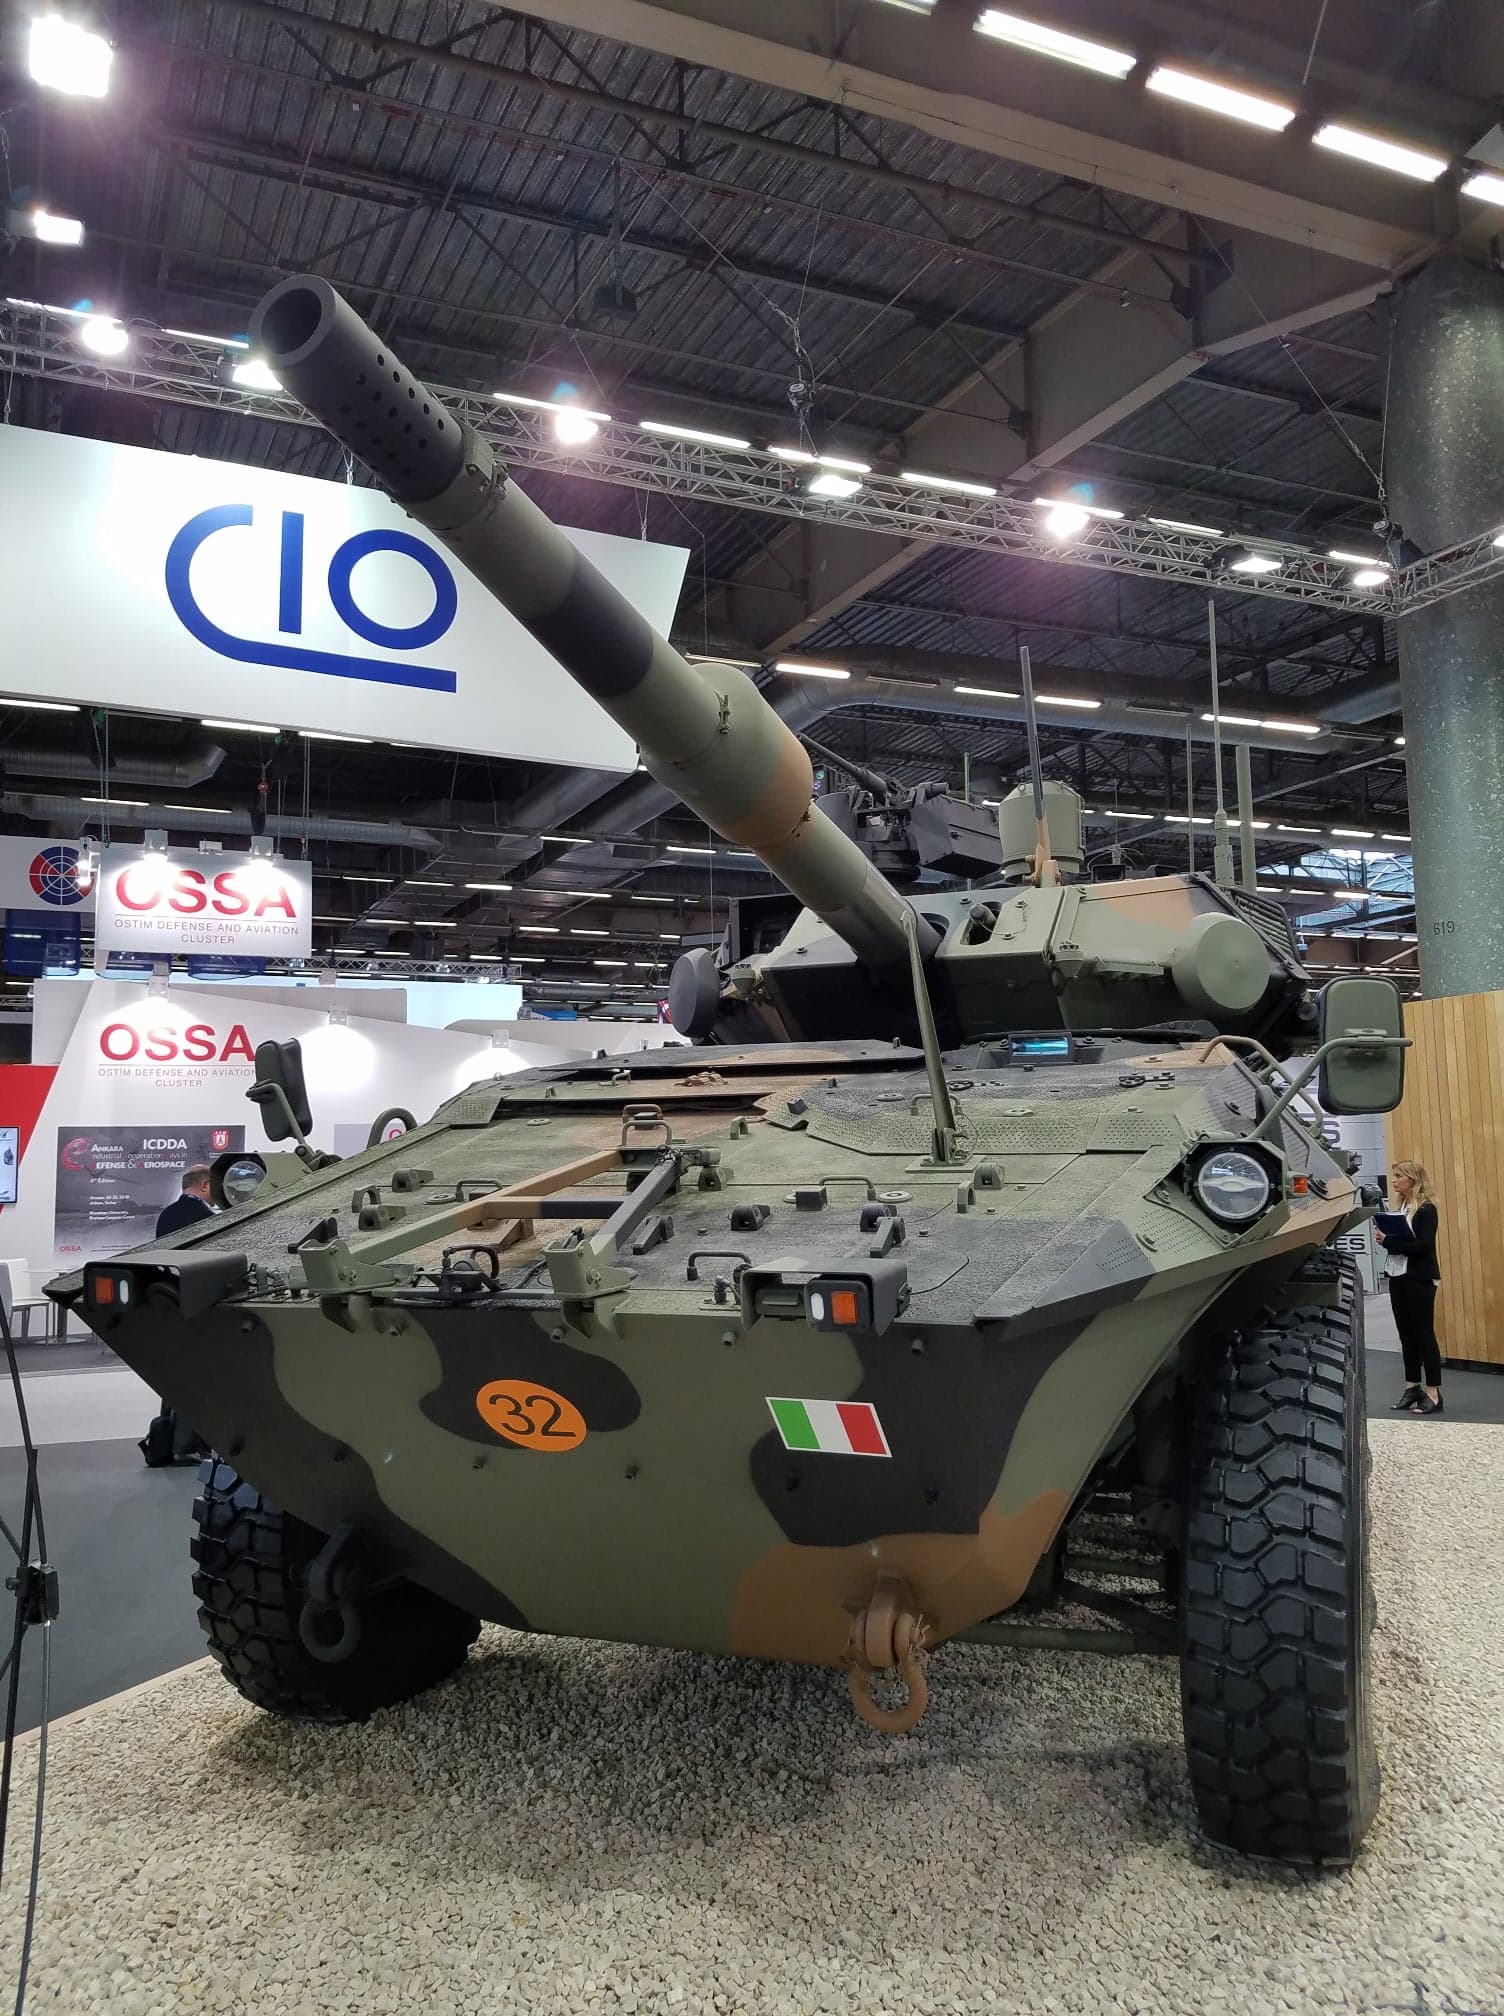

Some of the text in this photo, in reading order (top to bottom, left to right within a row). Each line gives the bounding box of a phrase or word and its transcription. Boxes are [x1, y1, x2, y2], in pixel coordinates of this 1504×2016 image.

[116, 869, 297, 918] OSSA
[115, 919, 299, 935] OSTIM DEFENSE AND AVIATION
[1433, 920, 1455, 935] 619
[181, 934, 235, 944] CLUSTER
[100, 1023, 256, 1062] OSSA
[98, 1068, 131, 1077] OSTIM
[135, 1068, 183, 1077] DEFENSE
[187, 1068, 208, 1077] AND
[155, 1079, 202, 1087] CLUSTER
[143, 1138, 188, 1150] ICDDA
[489, 1394, 577, 1437] 32
